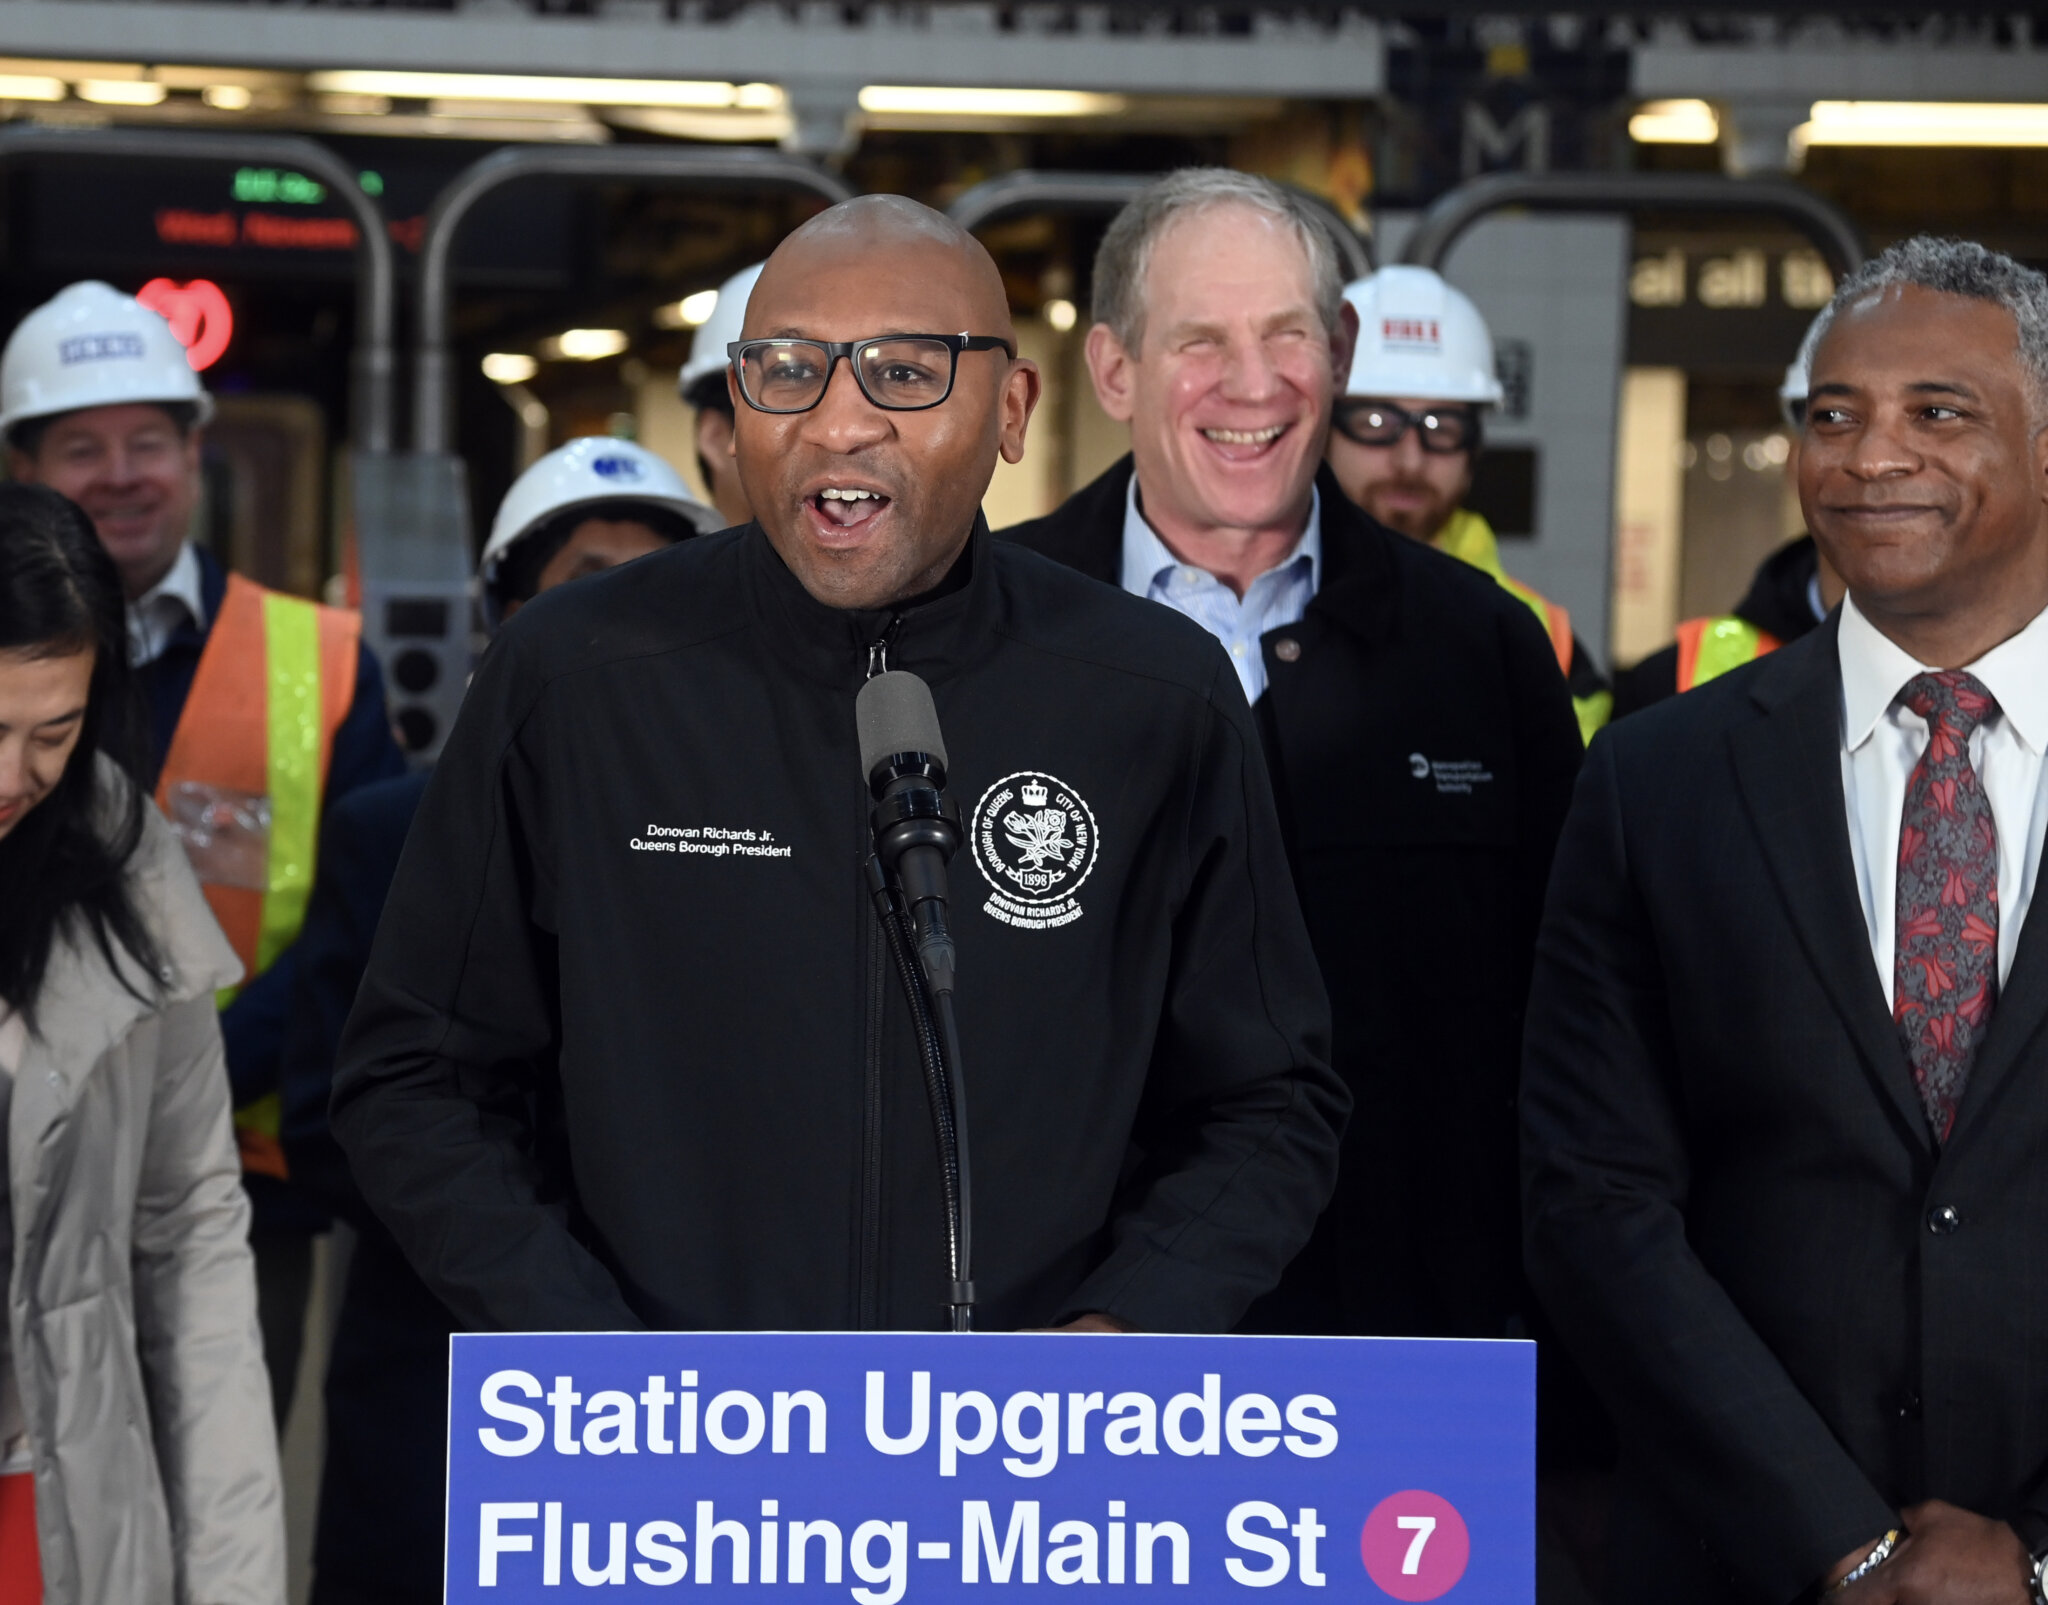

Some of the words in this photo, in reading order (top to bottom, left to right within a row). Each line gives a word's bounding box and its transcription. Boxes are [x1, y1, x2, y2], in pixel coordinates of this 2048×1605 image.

[1461, 103, 1549, 175] M
[986, 788, 1014, 817] QUEENS
[1056, 793, 1076, 811] CITY
[982, 816, 994, 829] OF
[1070, 810, 1082, 822] OF
[647, 824, 700, 838] Donovan
[703, 827, 756, 841] Richards
[759, 830, 775, 841] Jr.
[1075, 824, 1088, 846] NEW
[630, 838, 676, 852] Queens
[679, 840, 730, 857] Borough
[733, 844, 791, 857] President
[981, 831, 1006, 873] BOROUGH
[1067, 847, 1086, 871] YORK
[1024, 873, 1047, 886] 1898
[983, 901, 1011, 923] QUEENS
[1010, 916, 1046, 929] BOROUGH
[1046, 906, 1084, 929] PRESIDENT
[989, 892, 1026, 916] DONOVAN
[1026, 902, 1067, 918] RICHARDS
[1067, 897, 1080, 910] JR.
[478, 1369, 827, 1457] Station
[865, 1370, 1339, 1478] Upgrades
[478, 1499, 1190, 1605] Flushing-Main
[1224, 1500, 1327, 1588] St
[1397, 1516, 1436, 1575] 7
